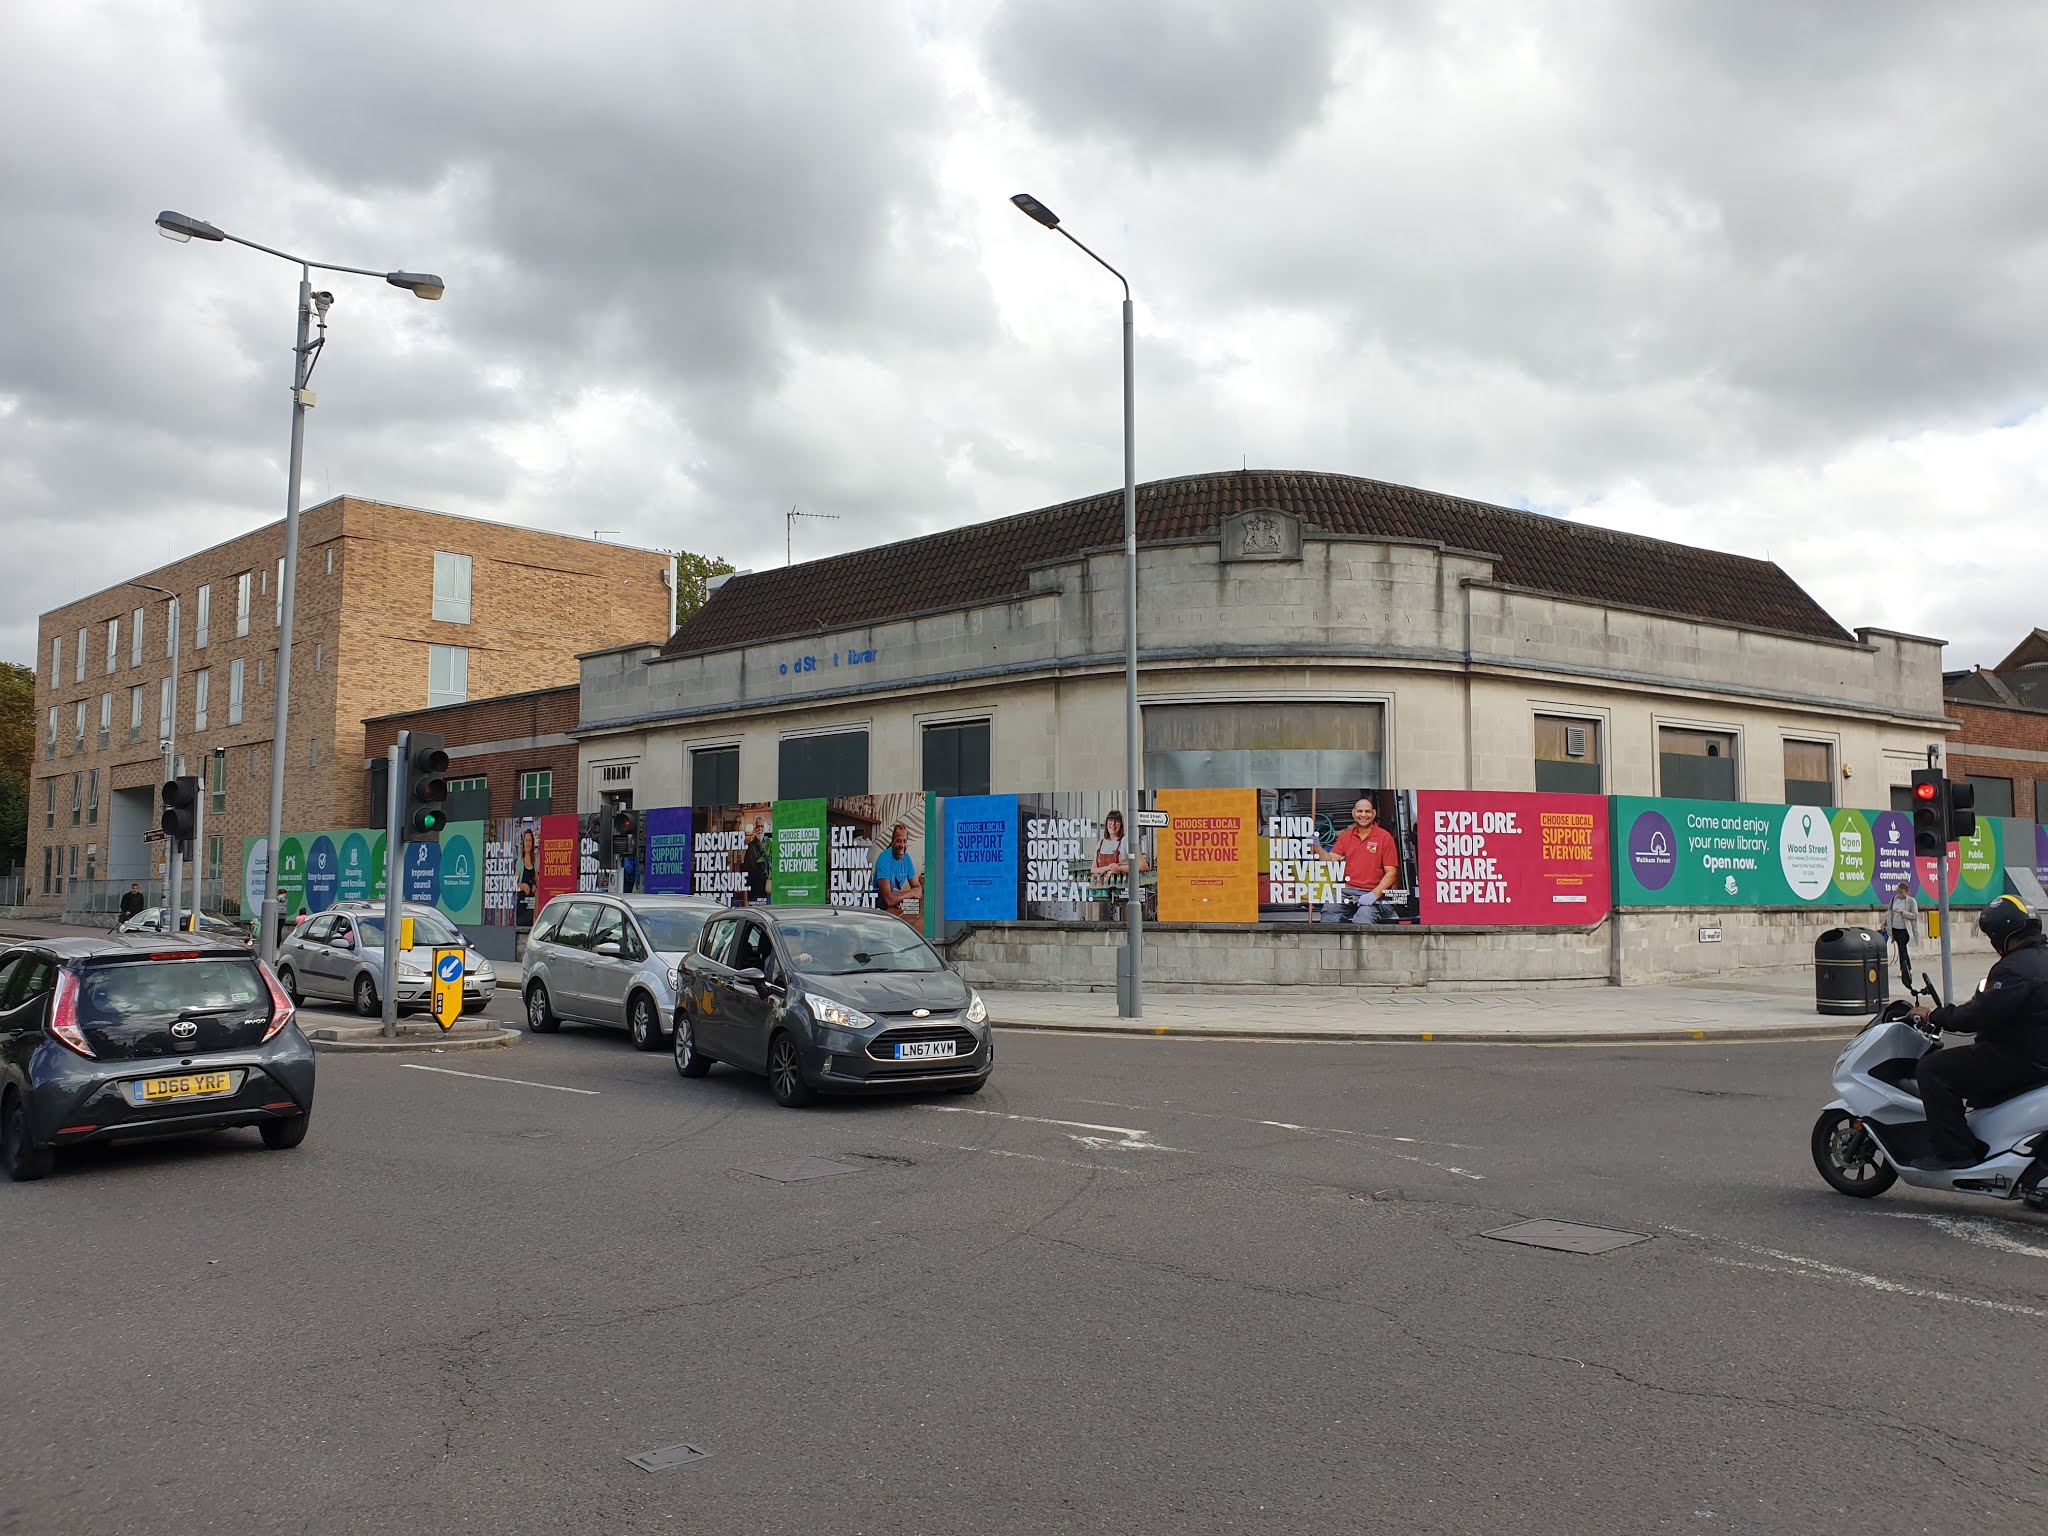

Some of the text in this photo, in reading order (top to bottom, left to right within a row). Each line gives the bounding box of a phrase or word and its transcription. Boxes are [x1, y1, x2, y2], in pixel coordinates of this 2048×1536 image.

[957, 822, 1004, 833] CHOOSE LOCAL
[1174, 819, 1239, 829] CHOOSE LOCAL
[1269, 817, 1320, 837] FIND.
[1434, 811, 1522, 834] EXPLORE.
[1542, 815, 1592, 826] CHOOSE LOCAL
[1687, 814, 1769, 835] Come and enjoy
[779, 829, 818, 840] CHOOSE LOCAL
[831, 826, 857, 846] EAT.
[1027, 819, 1096, 838] SEARCH.
[545, 839, 573, 849] CHOOSE LOCAL
[652, 835, 685, 845] CHOOSE LOCAL
[694, 831, 749, 851] DISCOVER.
[958, 834, 1003, 849] SUPPORT
[1175, 832, 1238, 847] SUPPORT
[1542, 828, 1591, 845] SUPPORT
[1841, 837, 1860, 849] Open
[485, 841, 513, 858] POP-IN.
[581, 838, 599, 855] CHA
[779, 842, 818, 858] SUPPORT
[1027, 840, 1085, 860] ORDER.
[1269, 839, 1320, 859] HIRE.
[1434, 835, 1487, 856] SHOP.
[1543, 845, 1593, 860] EVERYONE
[1688, 836, 1770, 854] your new library.
[1787, 844, 1828, 854] Wood Street
[1880, 847, 1909, 857] Brand new
[545, 851, 572, 864] SUPPORT
[652, 847, 684, 861] SUPPORT
[694, 852, 730, 871] TREAT.
[831, 848, 872, 868] DRINK.
[958, 850, 1003, 863] EVERYONE
[1175, 848, 1239, 861] EVERYONE
[1840, 855, 1863, 868] 7 days
[1968, 850, 1984, 859] Public
[485, 859, 514, 875] SELECT.
[545, 865, 571, 876] EVERYONE
[651, 862, 684, 875] EVERYONE
[779, 859, 818, 872] EVERYONE
[1027, 861, 1073, 880] SWIG.
[1269, 861, 1350, 881] REVIEW.
[1435, 858, 1502, 880] SHARE.
[1703, 854, 1757, 873] Open now.
[1892, 859, 1900, 868] for
[1901, 859, 1910, 868] the
[1963, 862, 1990, 871] computers
[411, 868, 434, 879] Improved
[831, 870, 873, 891] ENJOY.
[1840, 871, 1865, 880] a week
[1880, 870, 1911, 882] community
[414, 880, 430, 889] council
[485, 876, 520, 892] RESTOCK.
[581, 874, 599, 892] BUY.
[694, 872, 751, 891] TREASURE.
[1885, 883, 1891, 892] to
[412, 892, 432, 901] services
[1027, 882, 1093, 902] REPEAT.
[1270, 883, 1349, 904] REPEAT.
[1436, 881, 1511, 903] REPEAT.
[485, 893, 514, 909] REPEAT.
[902, 1042, 954, 1056] LN67 KVM
[146, 1074, 226, 1096] LD66 YRF
